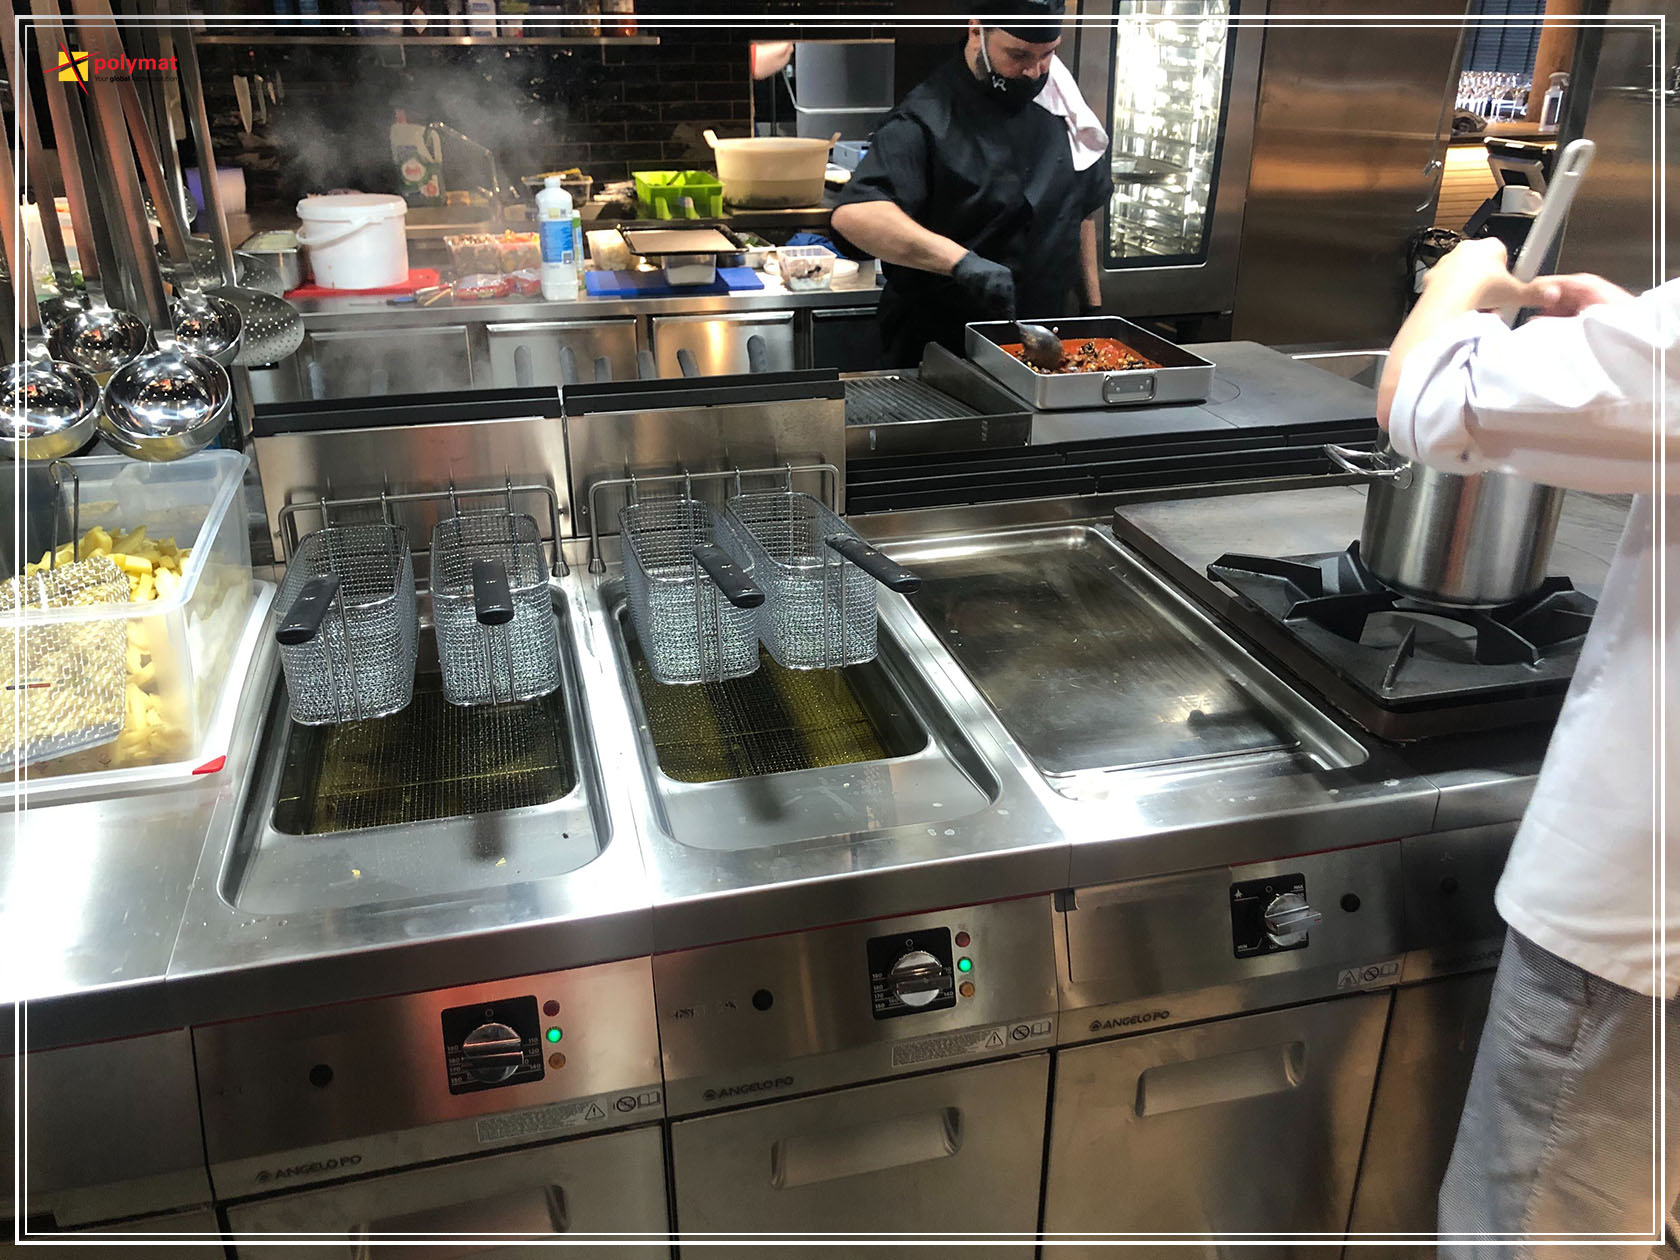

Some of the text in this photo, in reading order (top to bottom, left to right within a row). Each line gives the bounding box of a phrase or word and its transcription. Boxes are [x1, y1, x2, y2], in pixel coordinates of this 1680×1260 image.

[1103, 1010, 1170, 1030] ANGELO PO
[719, 1076, 795, 1099] ANGELO PO
